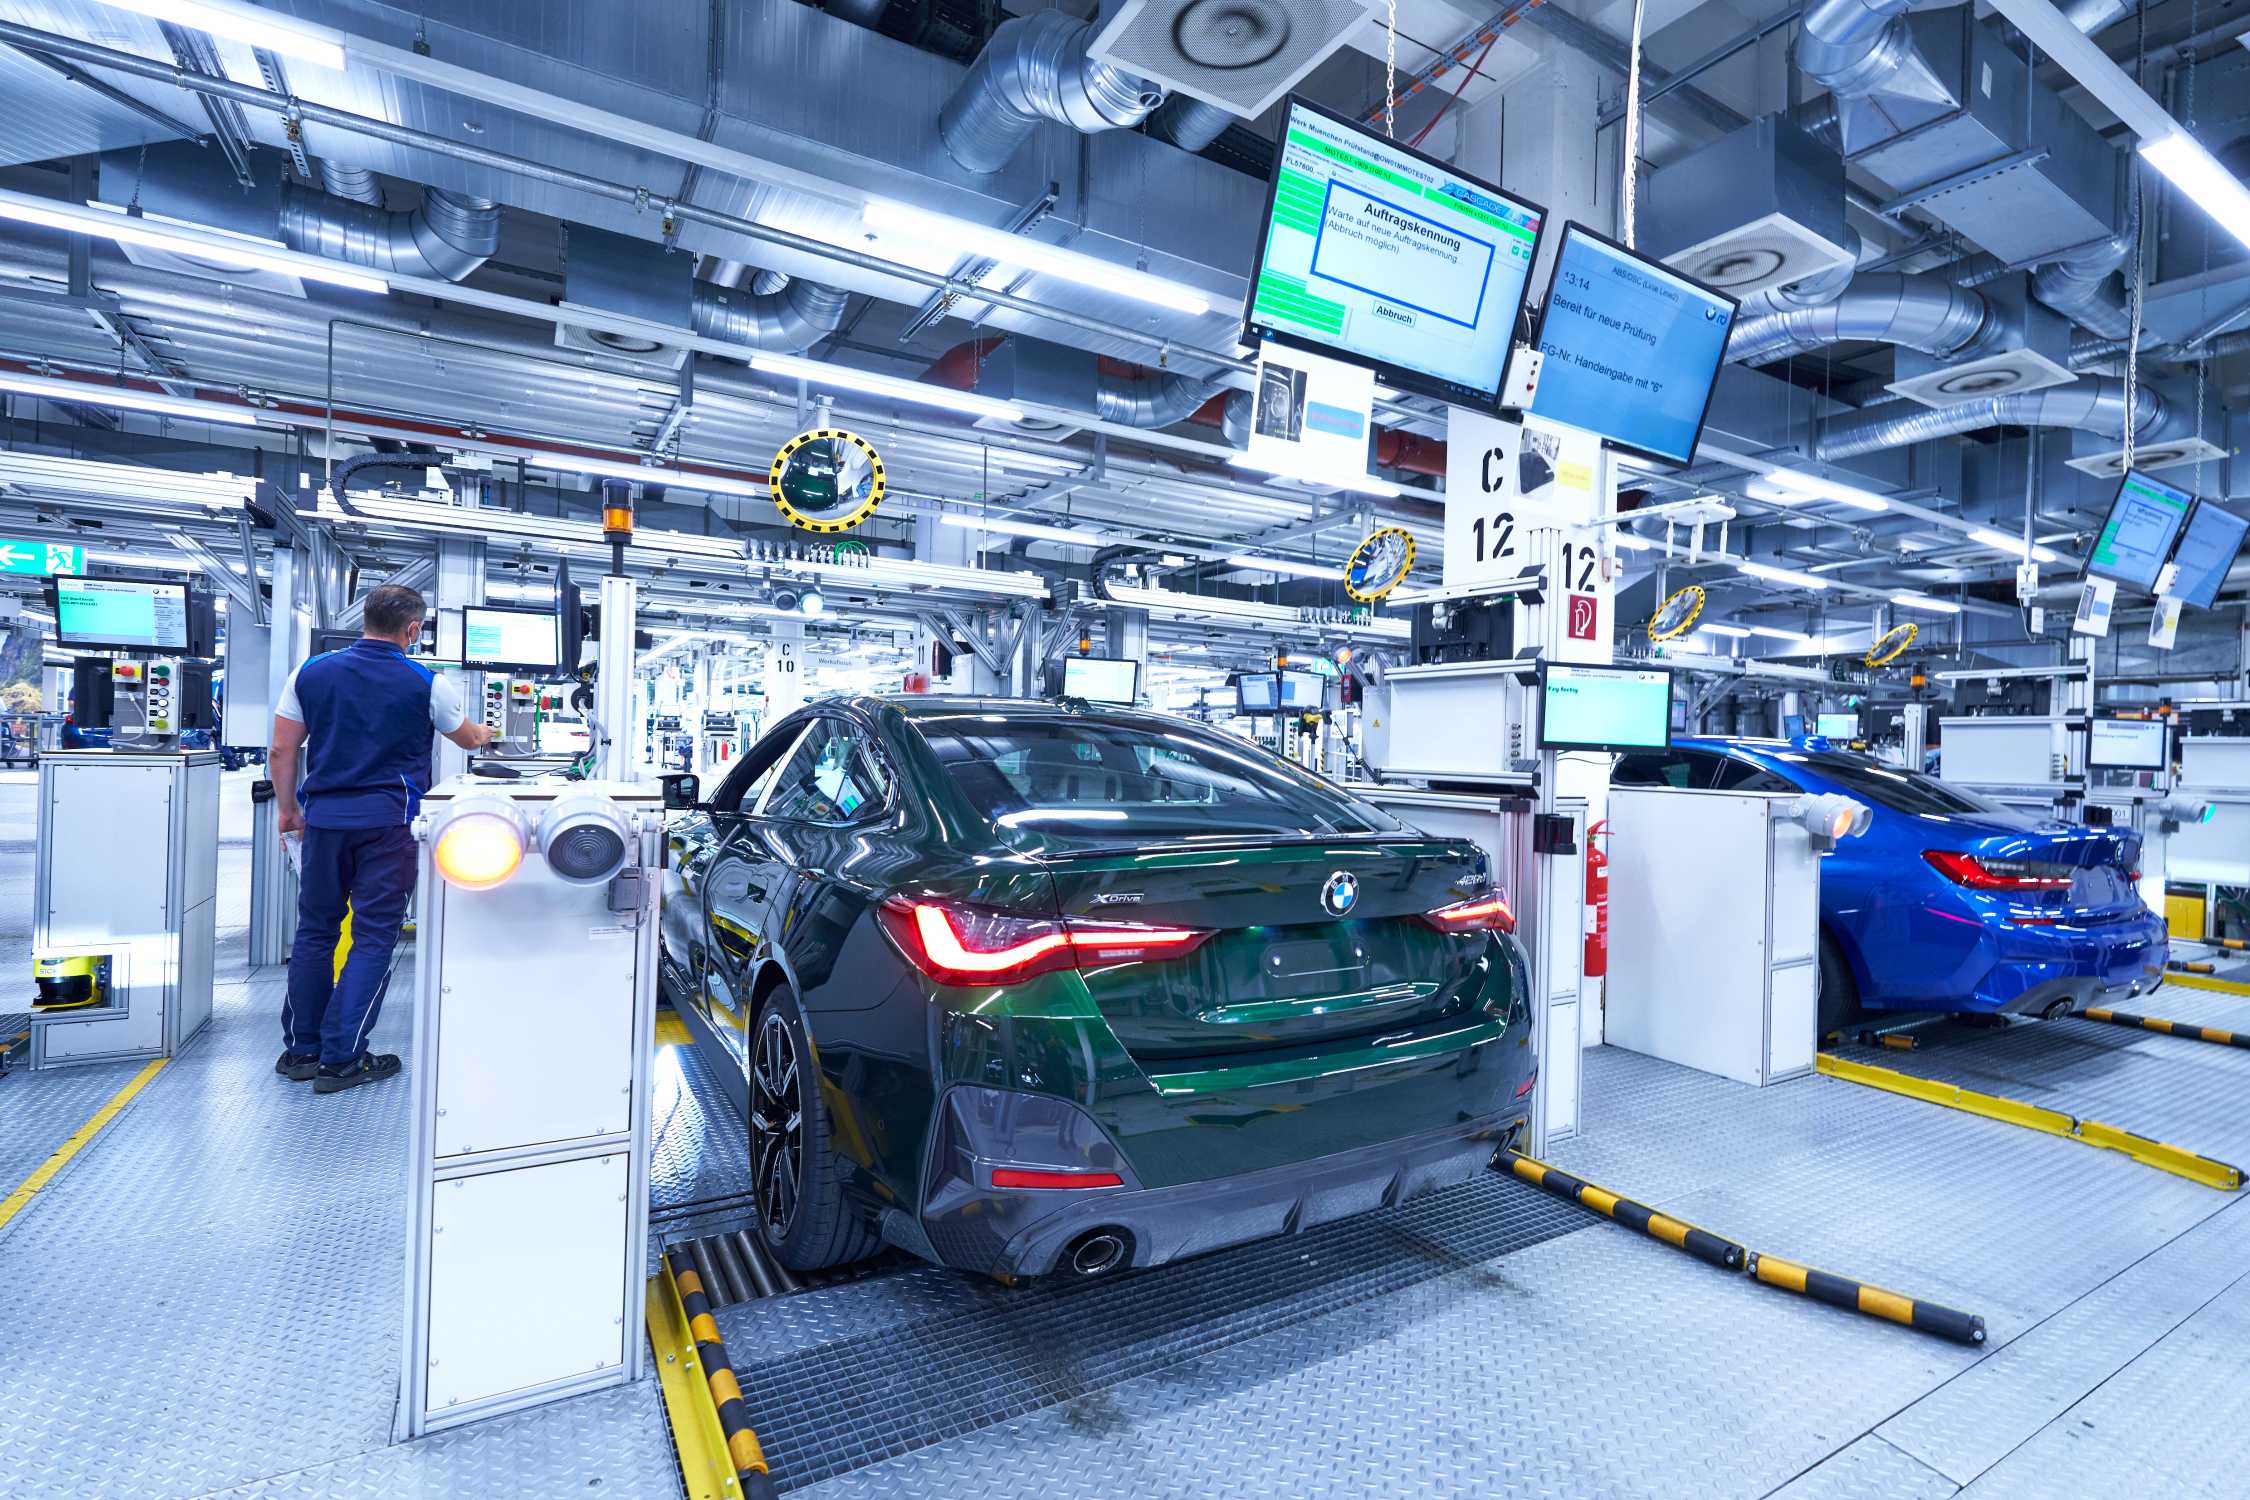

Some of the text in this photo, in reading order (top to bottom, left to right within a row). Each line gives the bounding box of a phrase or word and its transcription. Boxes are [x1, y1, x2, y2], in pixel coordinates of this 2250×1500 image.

[1290, 116, 1307, 128] Werk
[1309, 122, 1343, 143] Muenchen
[1324, 218, 1400, 256] (Abbruch möglich)
[1328, 205, 1354, 222] Warte
[1356, 216, 1371, 228] auf
[1372, 224, 1392, 238] neue
[1364, 203, 1461, 251] Auftragskennung
[1564, 271, 1590, 291] 13:14
[1376, 305, 1412, 325] Abbruch
[1553, 294, 1657, 346] Bereit für neue Prüfung
[1540, 342, 1571, 364] FG-Nr.
[1574, 354, 1634, 384] Handeingabe
[1635, 375, 1649, 390] mit
[1481, 447, 1504, 493] C
[1473, 512, 1514, 563] 12
[1562, 542, 1595, 592] 12
[777, 660, 795, 673] 10
[782, 643, 790, 656] C
